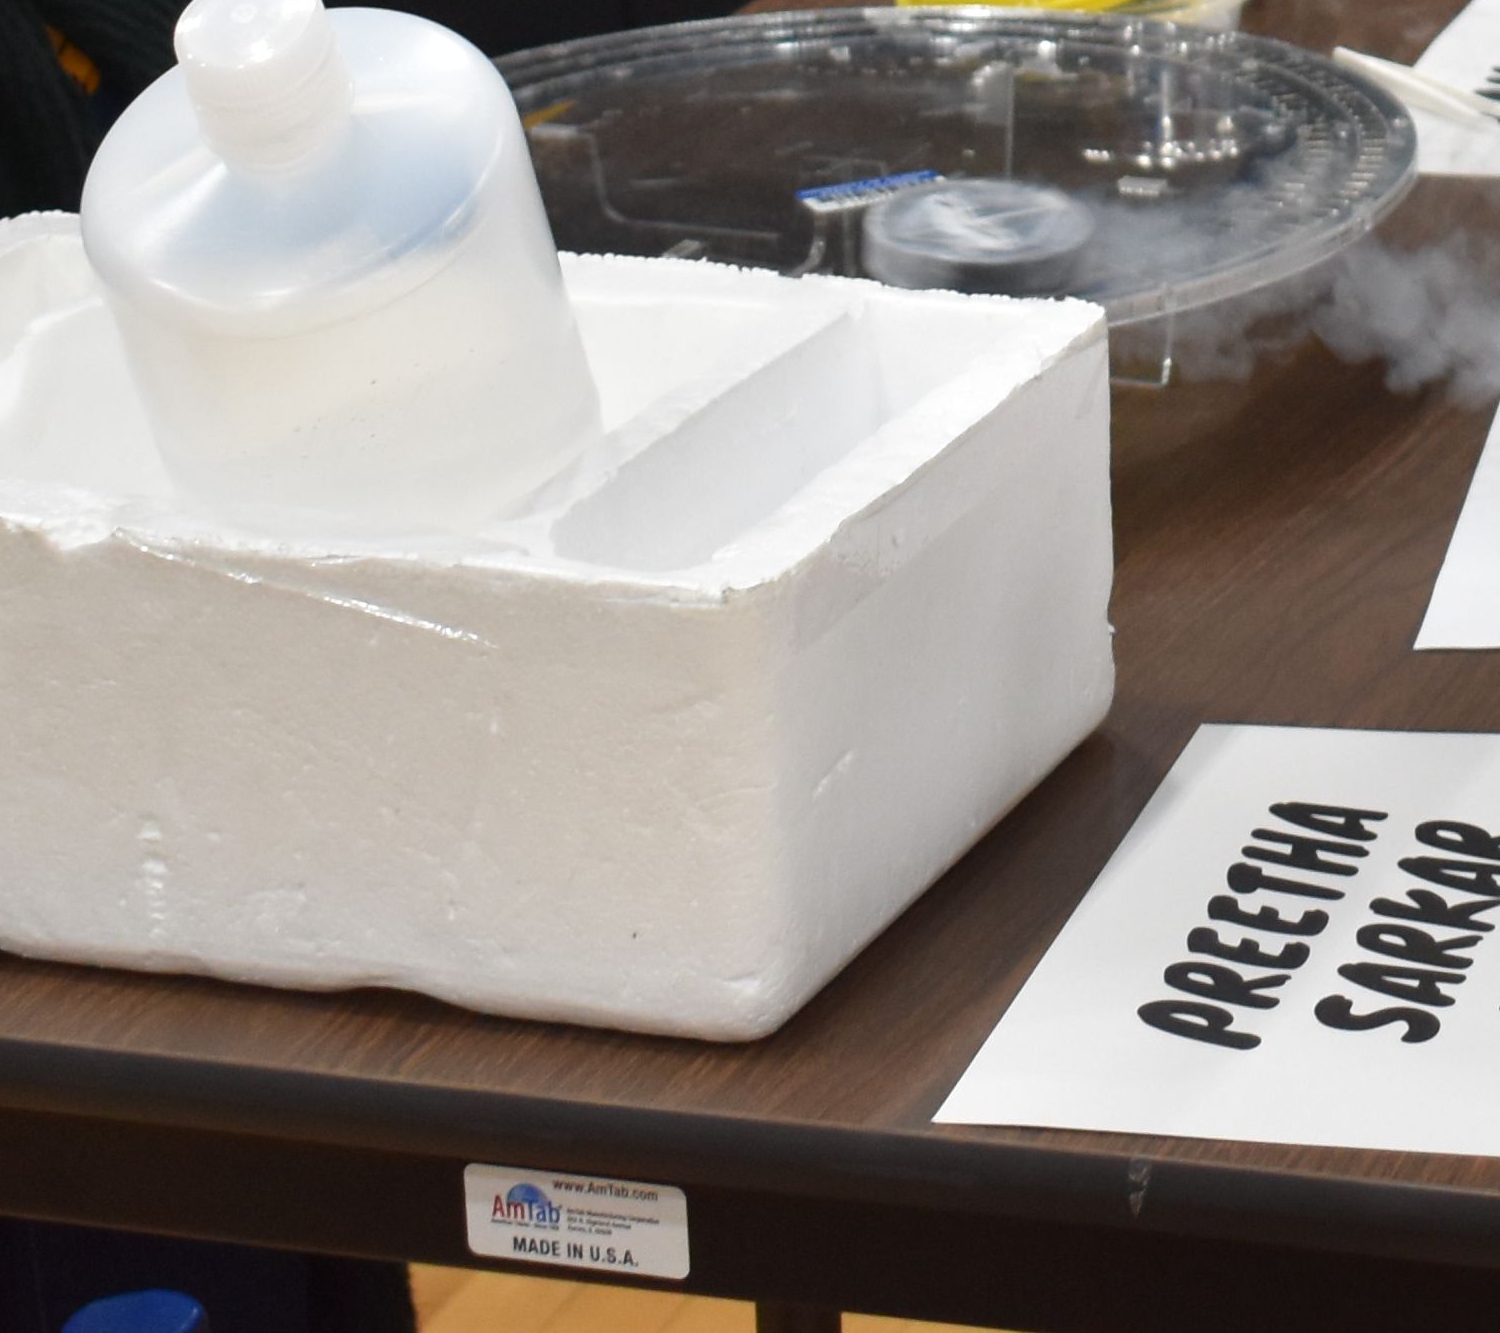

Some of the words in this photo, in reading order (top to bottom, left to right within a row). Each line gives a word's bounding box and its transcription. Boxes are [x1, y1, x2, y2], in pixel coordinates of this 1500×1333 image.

[1137, 801, 1389, 1051] PREETHA
[552, 1178, 659, 1203] www.AmTab.com
[491, 1193, 561, 1224] AmTab
[512, 1236, 560, 1258] MADE
[566, 1244, 584, 1260] IN
[589, 1246, 640, 1268] U.S.A.
